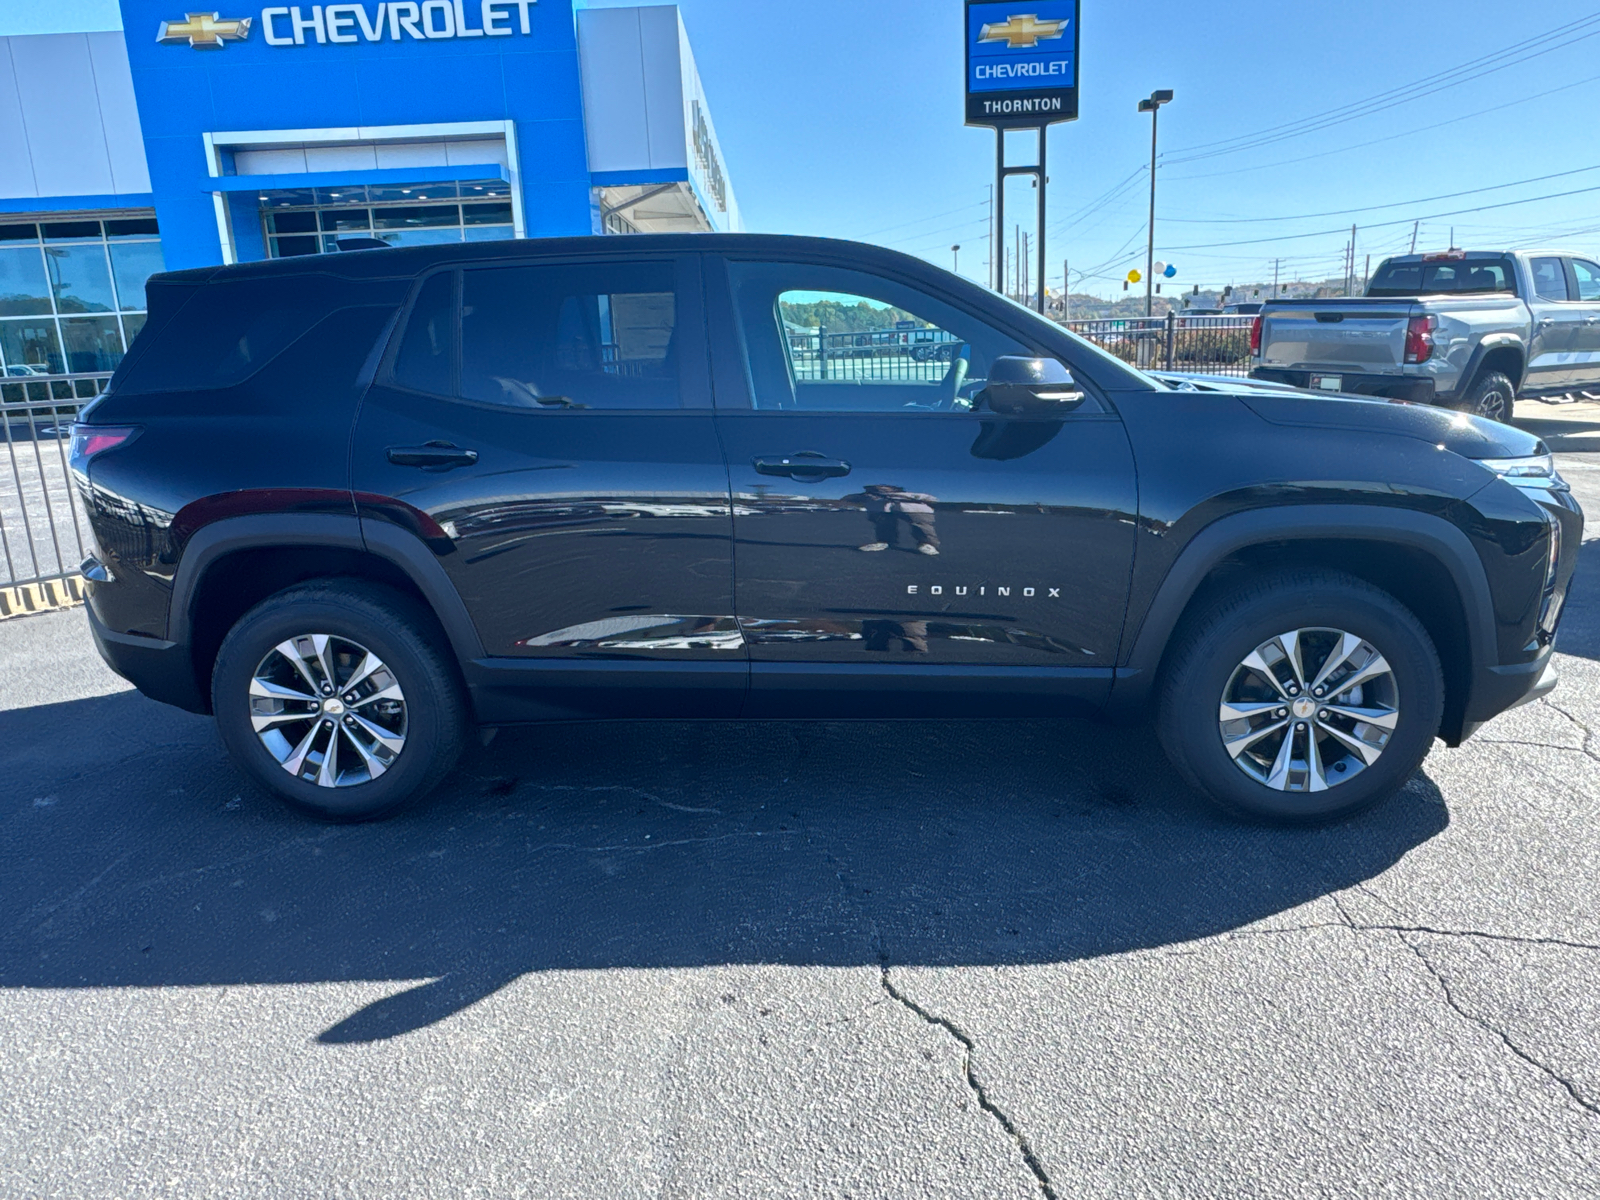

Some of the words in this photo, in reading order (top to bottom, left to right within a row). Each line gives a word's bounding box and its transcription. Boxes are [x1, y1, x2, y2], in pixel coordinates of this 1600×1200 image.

[261, 0, 538, 46] CHEVROLET
[975, 60, 1069, 79] CHEVROLET
[983, 97, 1061, 113] THORNTON
[907, 585, 1060, 598] EQUINOX
